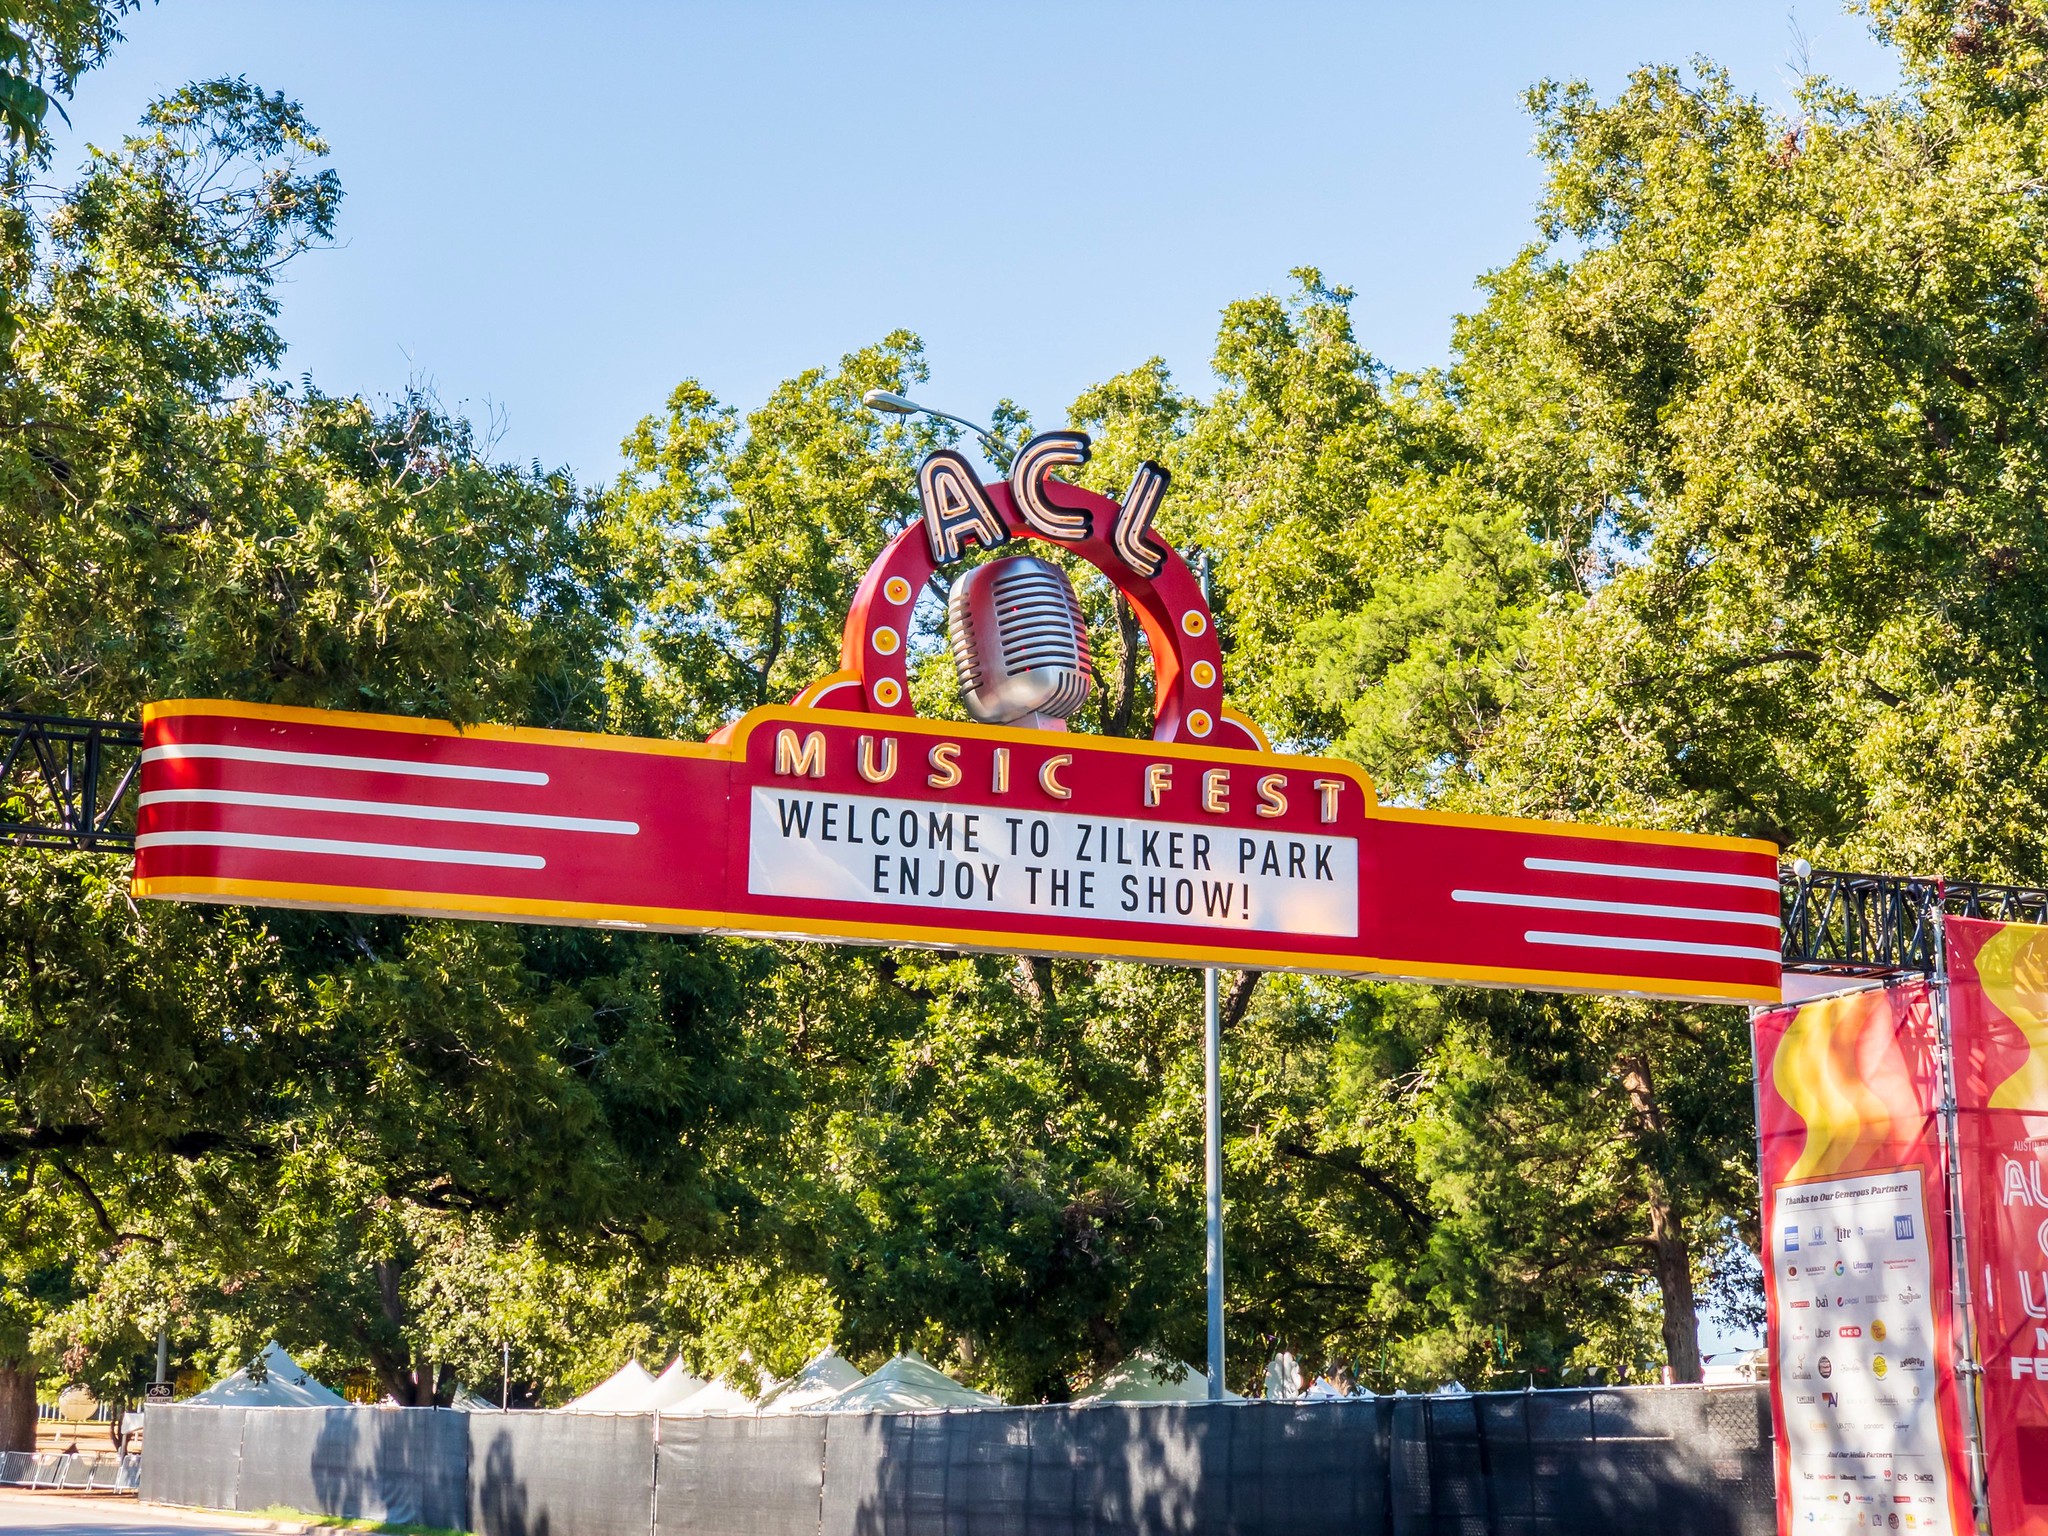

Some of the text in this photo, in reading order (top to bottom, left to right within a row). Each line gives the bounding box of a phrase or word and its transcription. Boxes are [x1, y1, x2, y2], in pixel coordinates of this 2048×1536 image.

[917, 430, 1172, 579] ACL
[775, 728, 1345, 823] MUSIC FEST
[778, 798, 1334, 881] WELCOME TO ZILKER PARK
[873, 854, 1249, 920] ENJOY THE SHOW!
[1785, 1183, 1909, 1206] Thanks to Our Generous Partners
[1836, 1227, 1852, 1243] Lite
[1815, 1328, 1831, 1339] Uber
[1866, 1451, 1893, 1459] Partners
